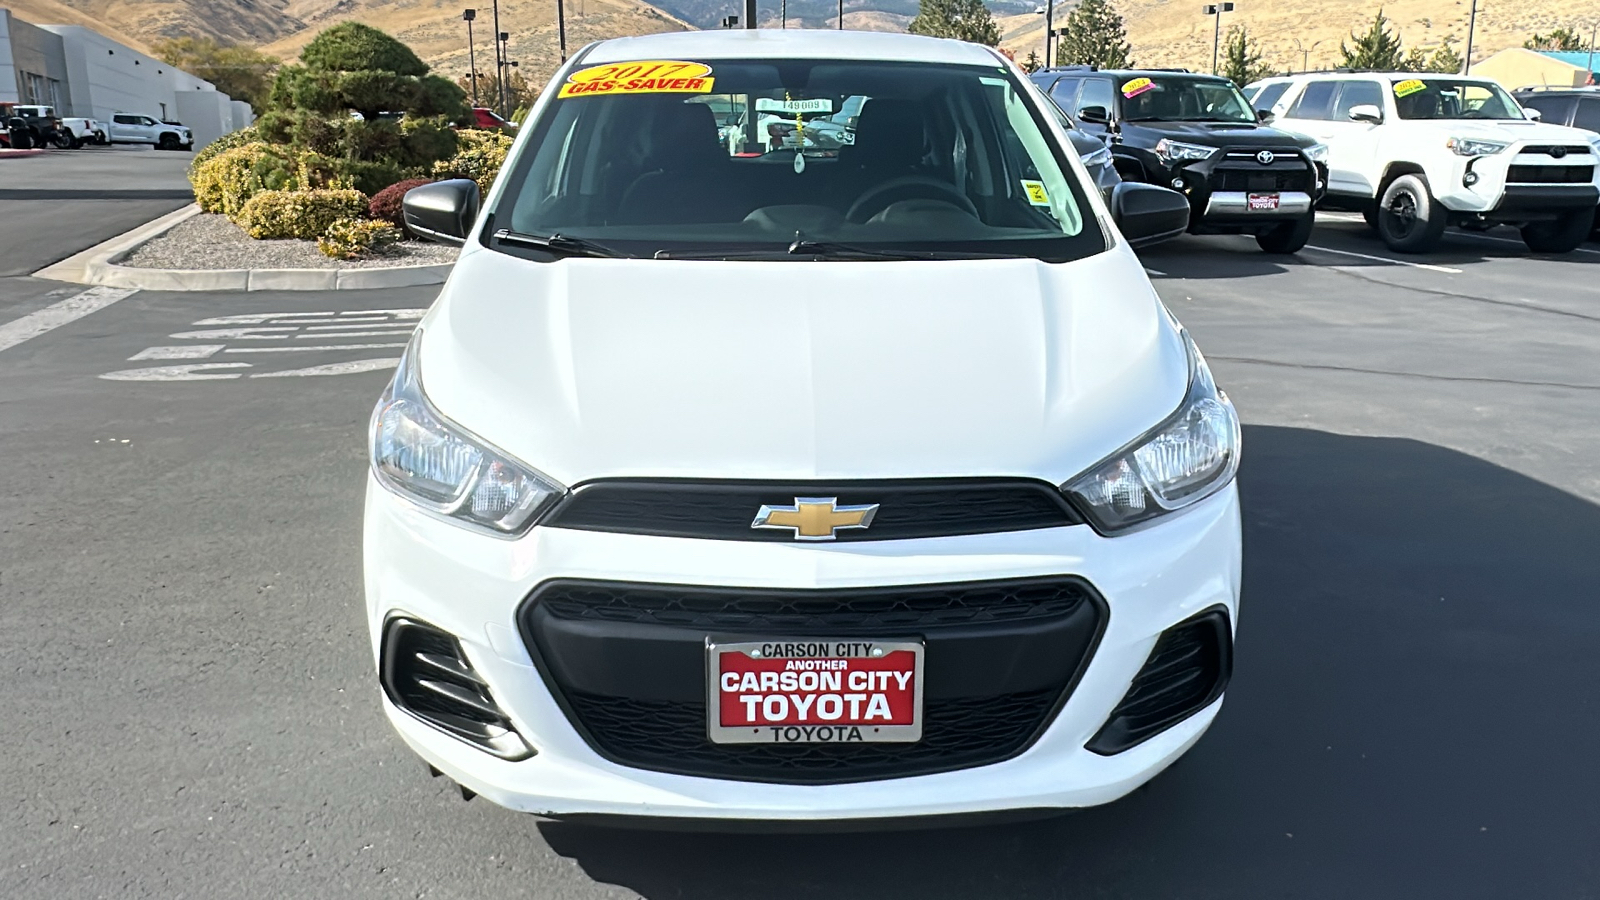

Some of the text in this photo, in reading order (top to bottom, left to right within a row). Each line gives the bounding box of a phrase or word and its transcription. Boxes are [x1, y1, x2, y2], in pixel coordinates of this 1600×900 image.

[591, 64, 690, 81] 2017
[567, 78, 706, 94] GAS-SAVER
[762, 643, 873, 658] CARSON CITY
[785, 660, 848, 670] ANOTHER
[721, 671, 913, 692] CARSON CITY
[739, 693, 893, 722] TOYOTA
[770, 726, 863, 742] TOYOTA
